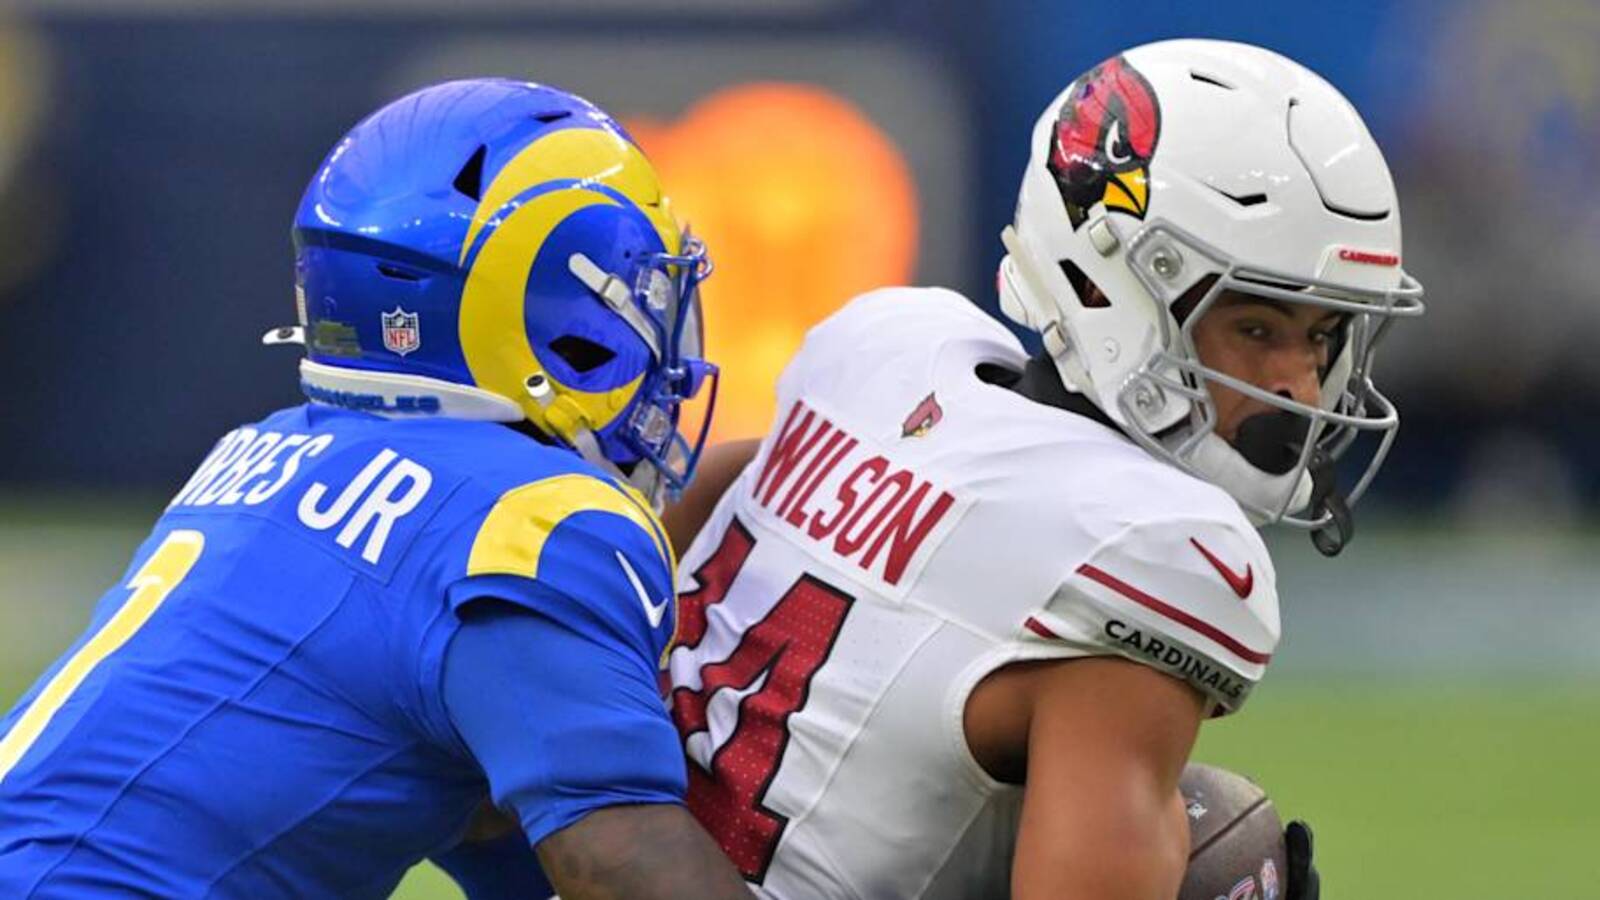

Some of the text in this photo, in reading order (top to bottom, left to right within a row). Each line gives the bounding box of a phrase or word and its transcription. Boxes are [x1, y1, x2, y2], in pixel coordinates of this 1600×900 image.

[386, 329, 417, 349] NFL
[297, 447, 433, 565] JR
[752, 399, 956, 586] WILSON
[1103, 618, 1244, 701] CARDINALS
